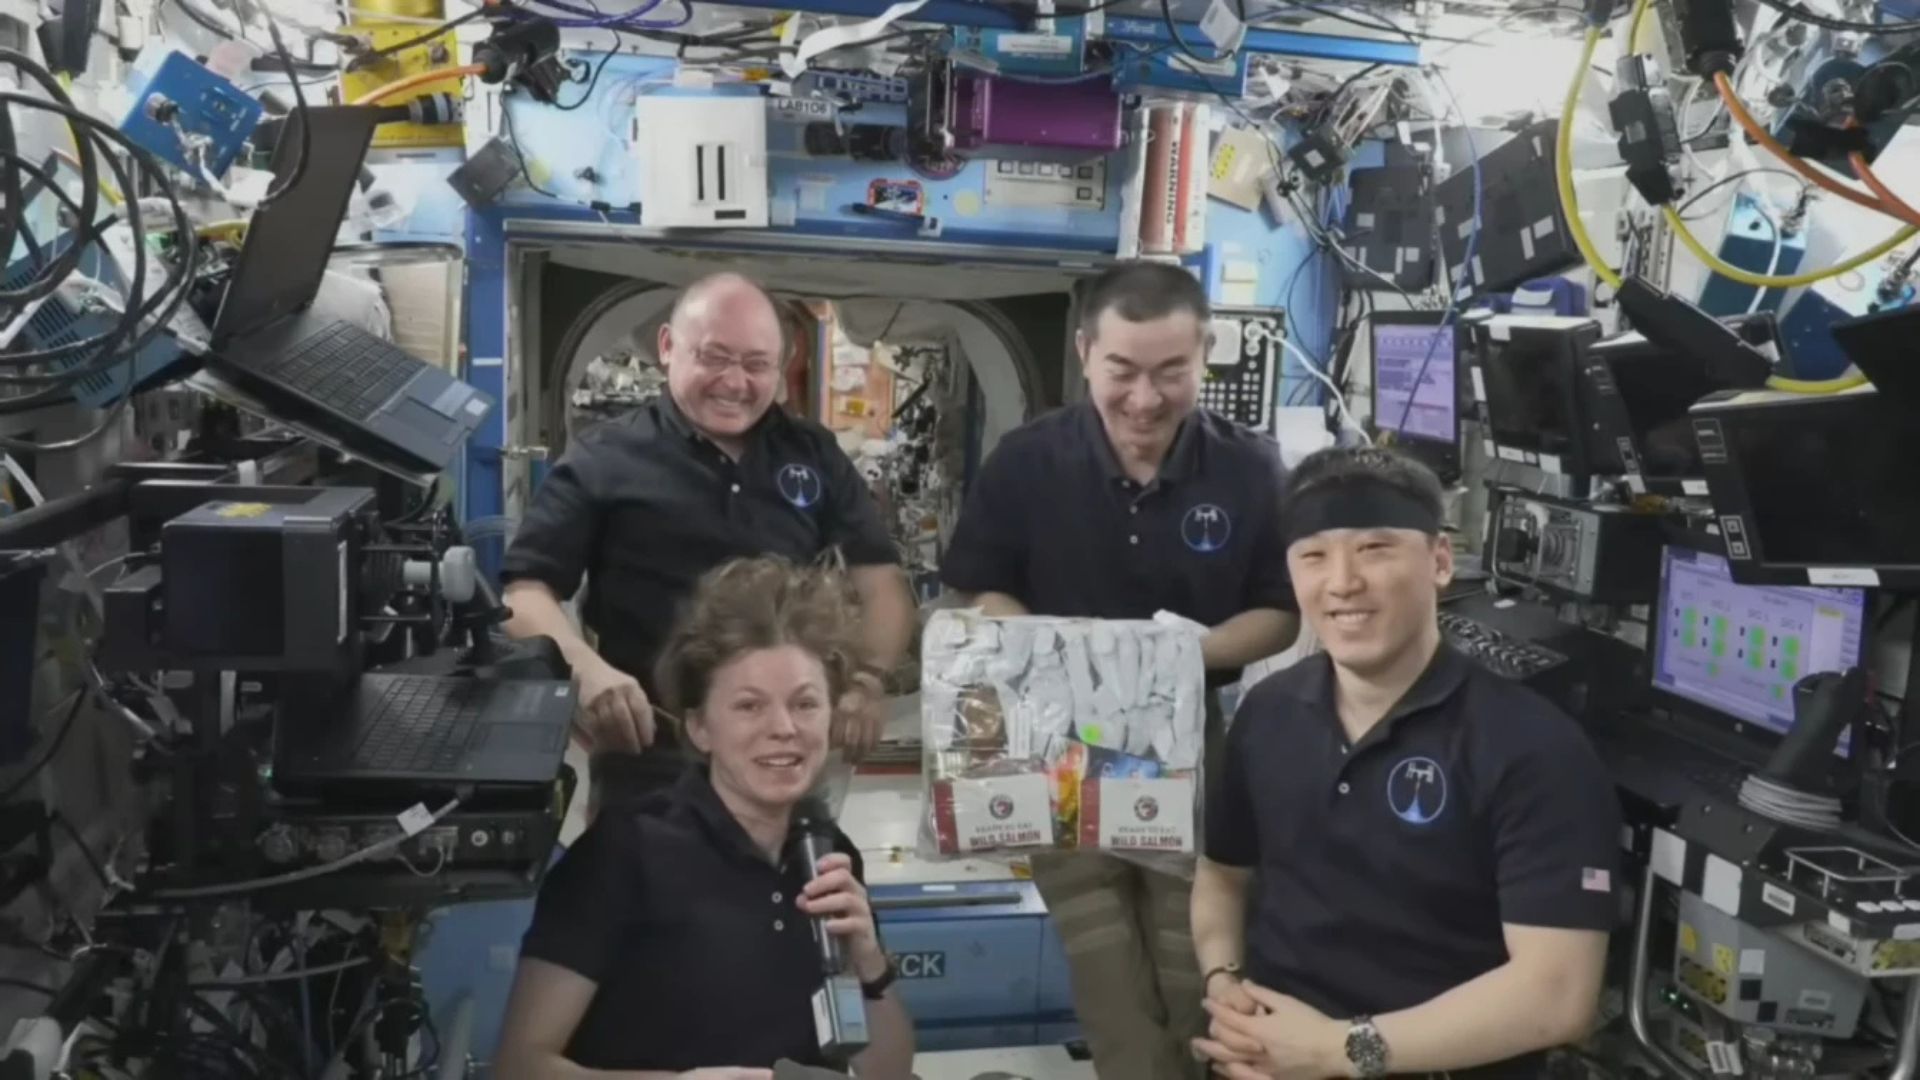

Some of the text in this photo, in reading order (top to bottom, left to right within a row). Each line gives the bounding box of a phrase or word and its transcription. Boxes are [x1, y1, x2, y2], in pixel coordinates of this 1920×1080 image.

[1166, 141, 1178, 224] WARNING
[969, 830, 1041, 846] WILD SALMON
[1111, 836, 1183, 848] WILD SALMON
